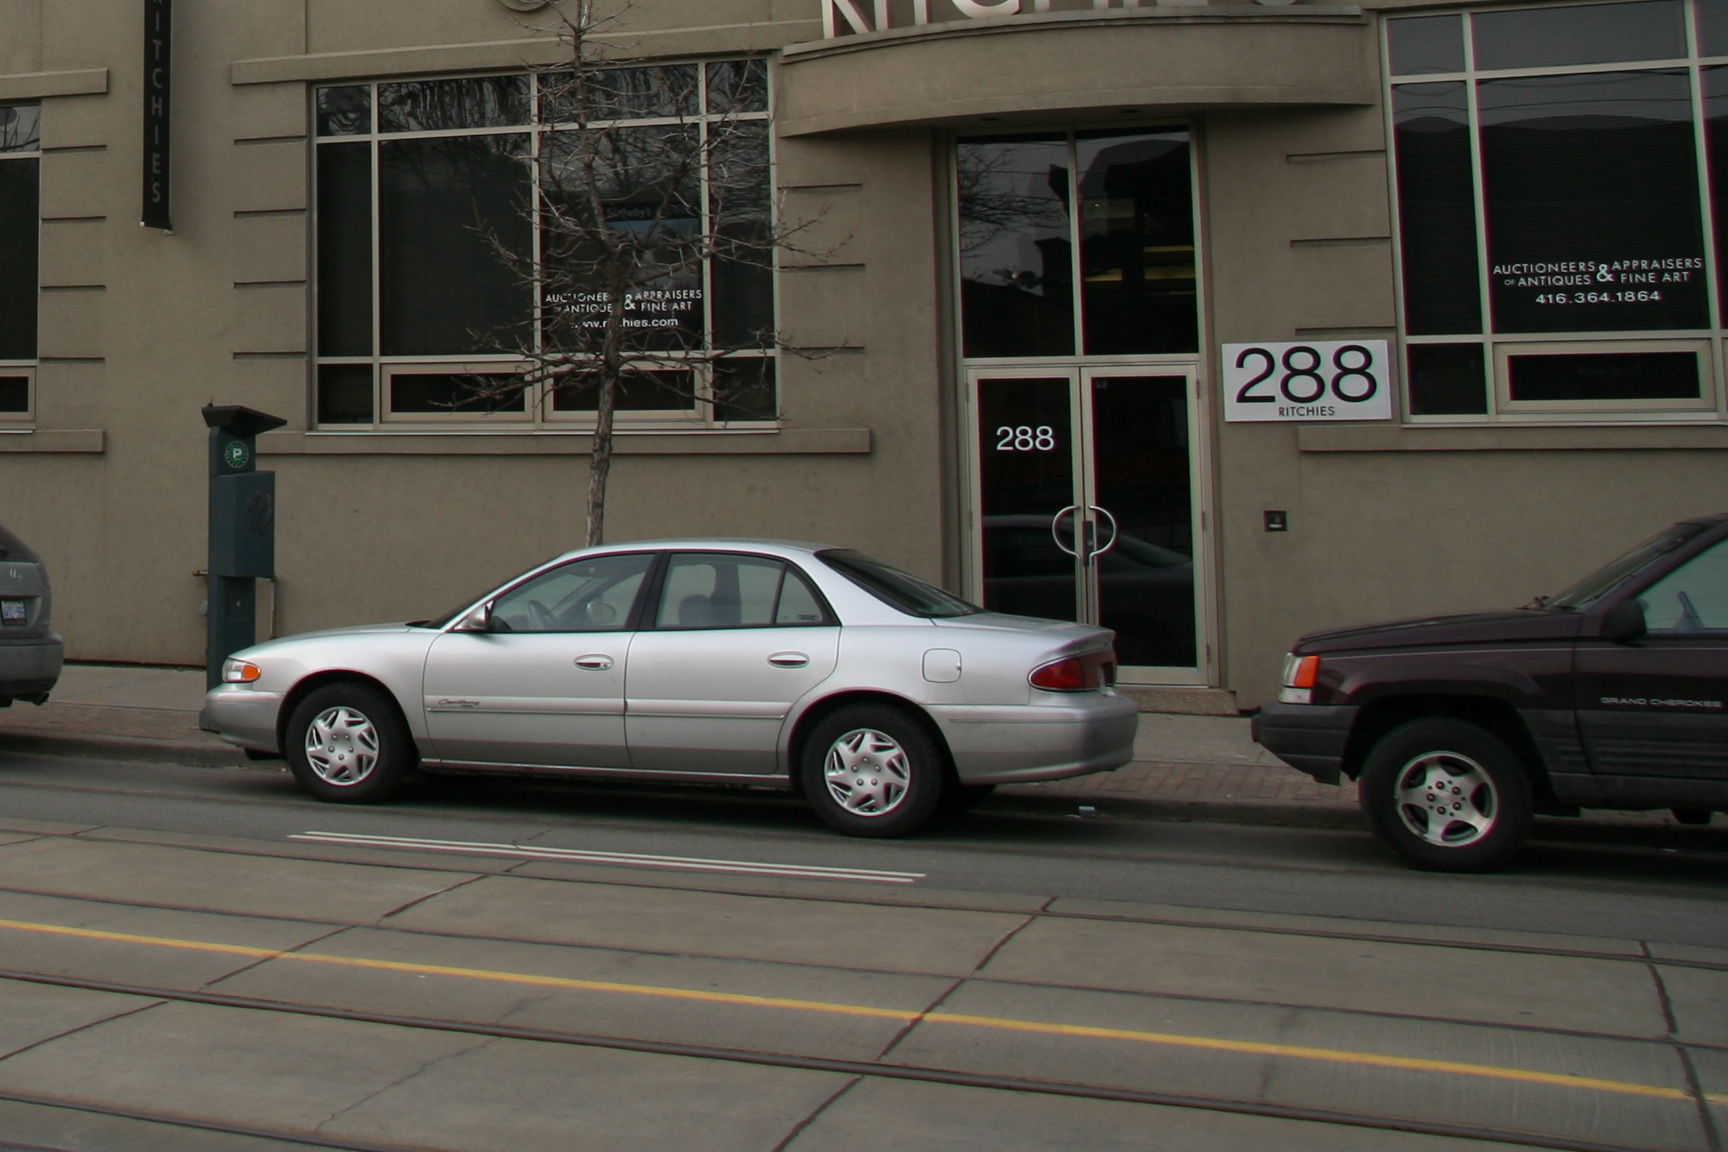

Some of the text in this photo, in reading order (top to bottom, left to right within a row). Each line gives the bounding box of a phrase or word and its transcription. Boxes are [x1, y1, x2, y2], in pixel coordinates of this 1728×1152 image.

[1493, 258, 1702, 282] AUCTIONEERS & APPRAISERS
[1517, 275, 1591, 287] ANTIQUES
[1621, 272, 1656, 283] FINE
[1661, 271, 1690, 282] ART
[624, 294, 636, 310] &
[635, 290, 702, 301] APPRAISERS
[1535, 291, 1661, 304] 416.364.1864
[641, 301, 667, 311] FINE
[672, 301, 692, 311] ART
[1235, 345, 1378, 403] 288
[1278, 406, 1336, 417] RITCHIES
[996, 425, 1055, 451] 288
[1649, 699, 1722, 707] CHEROKEE
